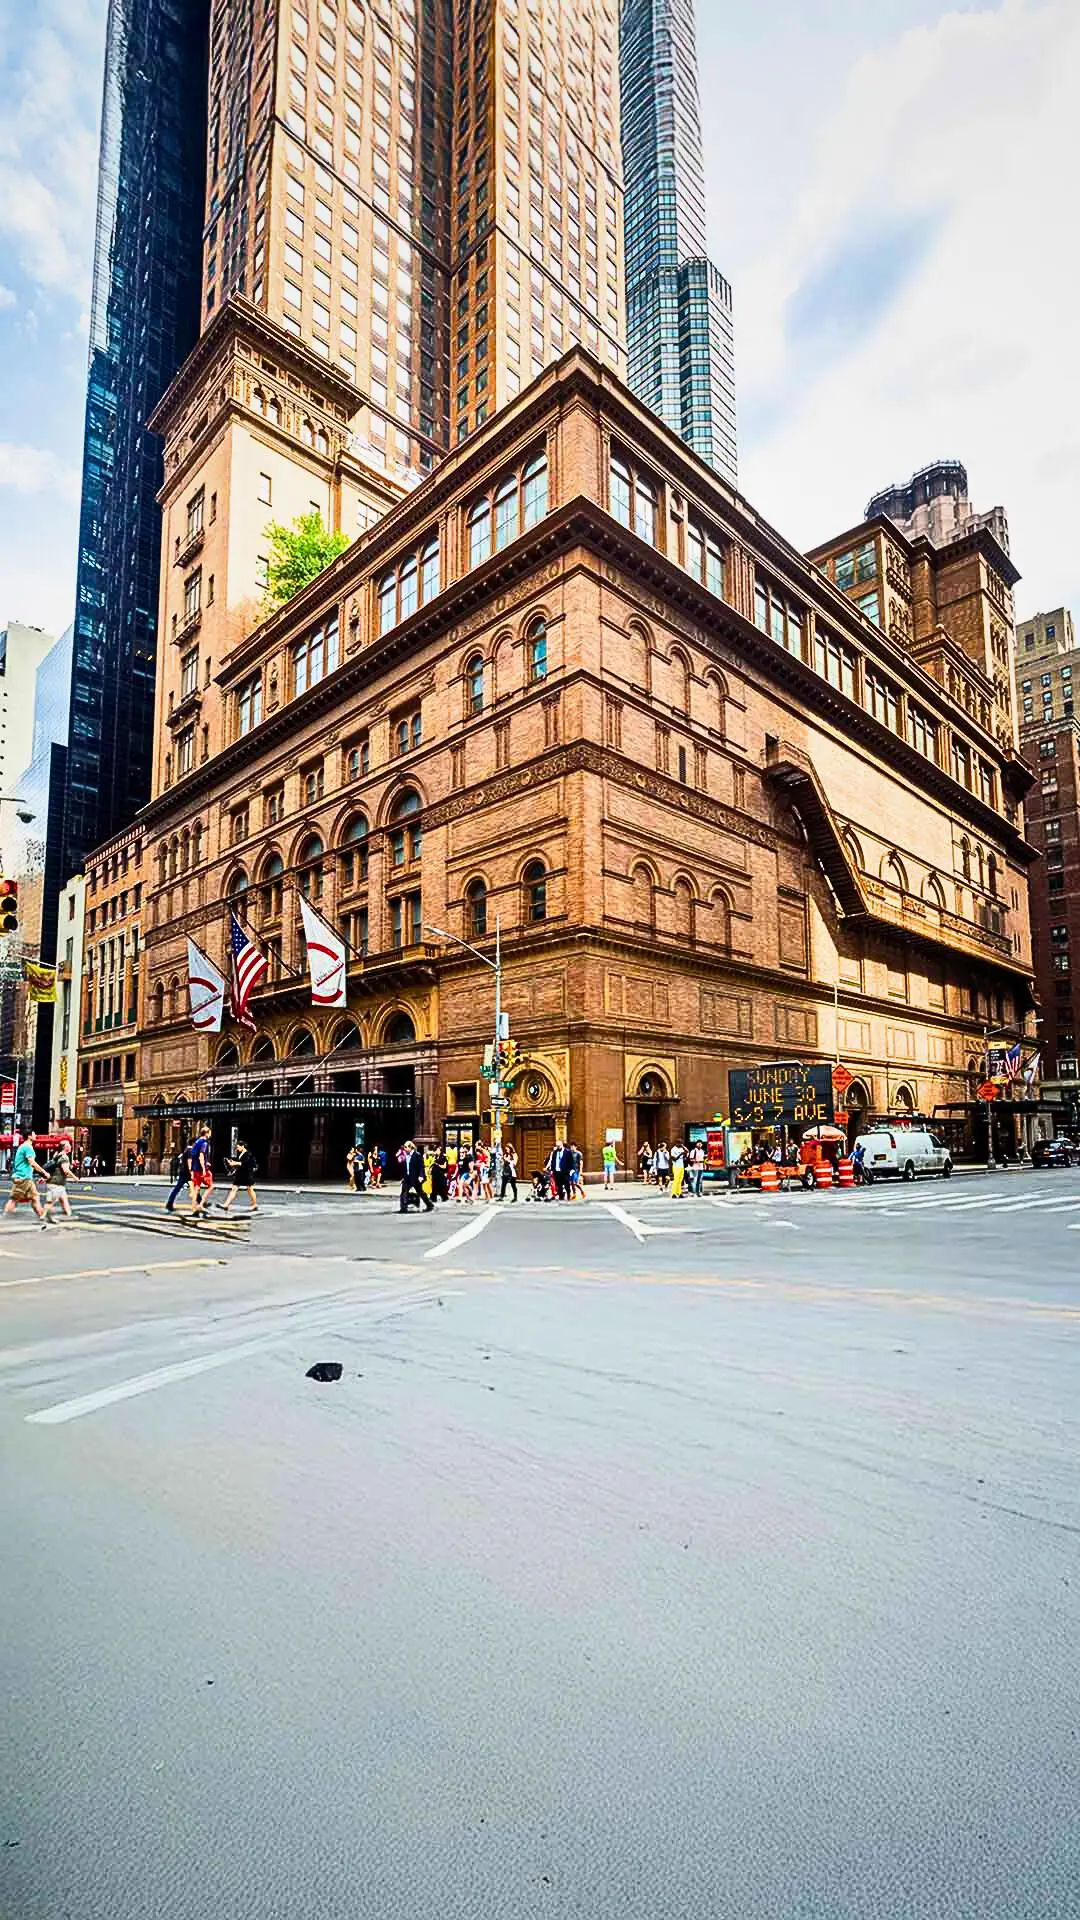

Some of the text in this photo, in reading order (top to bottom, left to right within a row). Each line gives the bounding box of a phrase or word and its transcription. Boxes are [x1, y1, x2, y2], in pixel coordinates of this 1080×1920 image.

[743, 1085, 816, 1104] JUNE 30
[773, 1106, 784, 1121] 7
[794, 1103, 828, 1121] AVE
